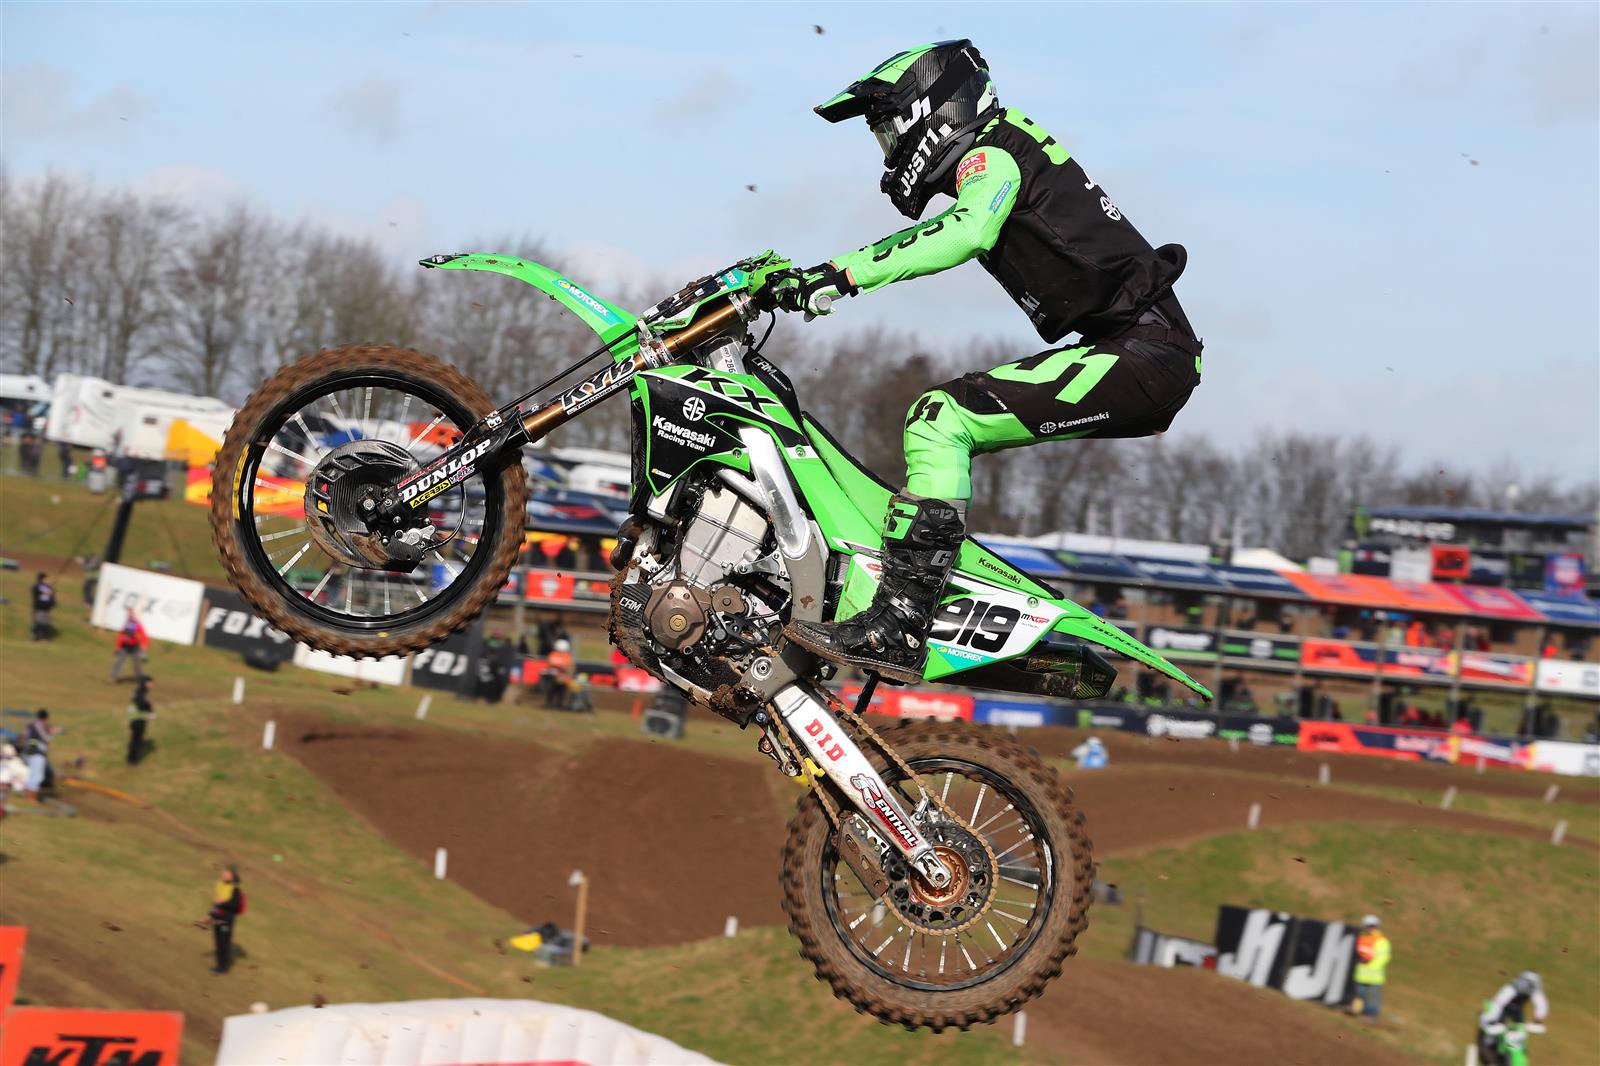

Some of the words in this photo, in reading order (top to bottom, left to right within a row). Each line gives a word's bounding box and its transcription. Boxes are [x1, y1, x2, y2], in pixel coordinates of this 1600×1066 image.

[569, 285, 609, 316] MOTOREX
[561, 355, 635, 410] KYB
[681, 367, 778, 417] KX
[652, 415, 717, 447] Kawasaki
[1058, 411, 1110, 429] Kawasaki
[657, 430, 686, 447] Racing
[686, 441, 706, 453] Team
[402, 438, 491, 503] DUNLOP
[412, 482, 450, 507] ACERBIS
[978, 557, 1022, 585] Kawasaki
[620, 596, 643, 612] CRM
[205, 606, 266, 640] FOX
[929, 597, 1022, 654] 919
[946, 647, 983, 662] MOTOREX
[804, 718, 846, 762] D.I.D
